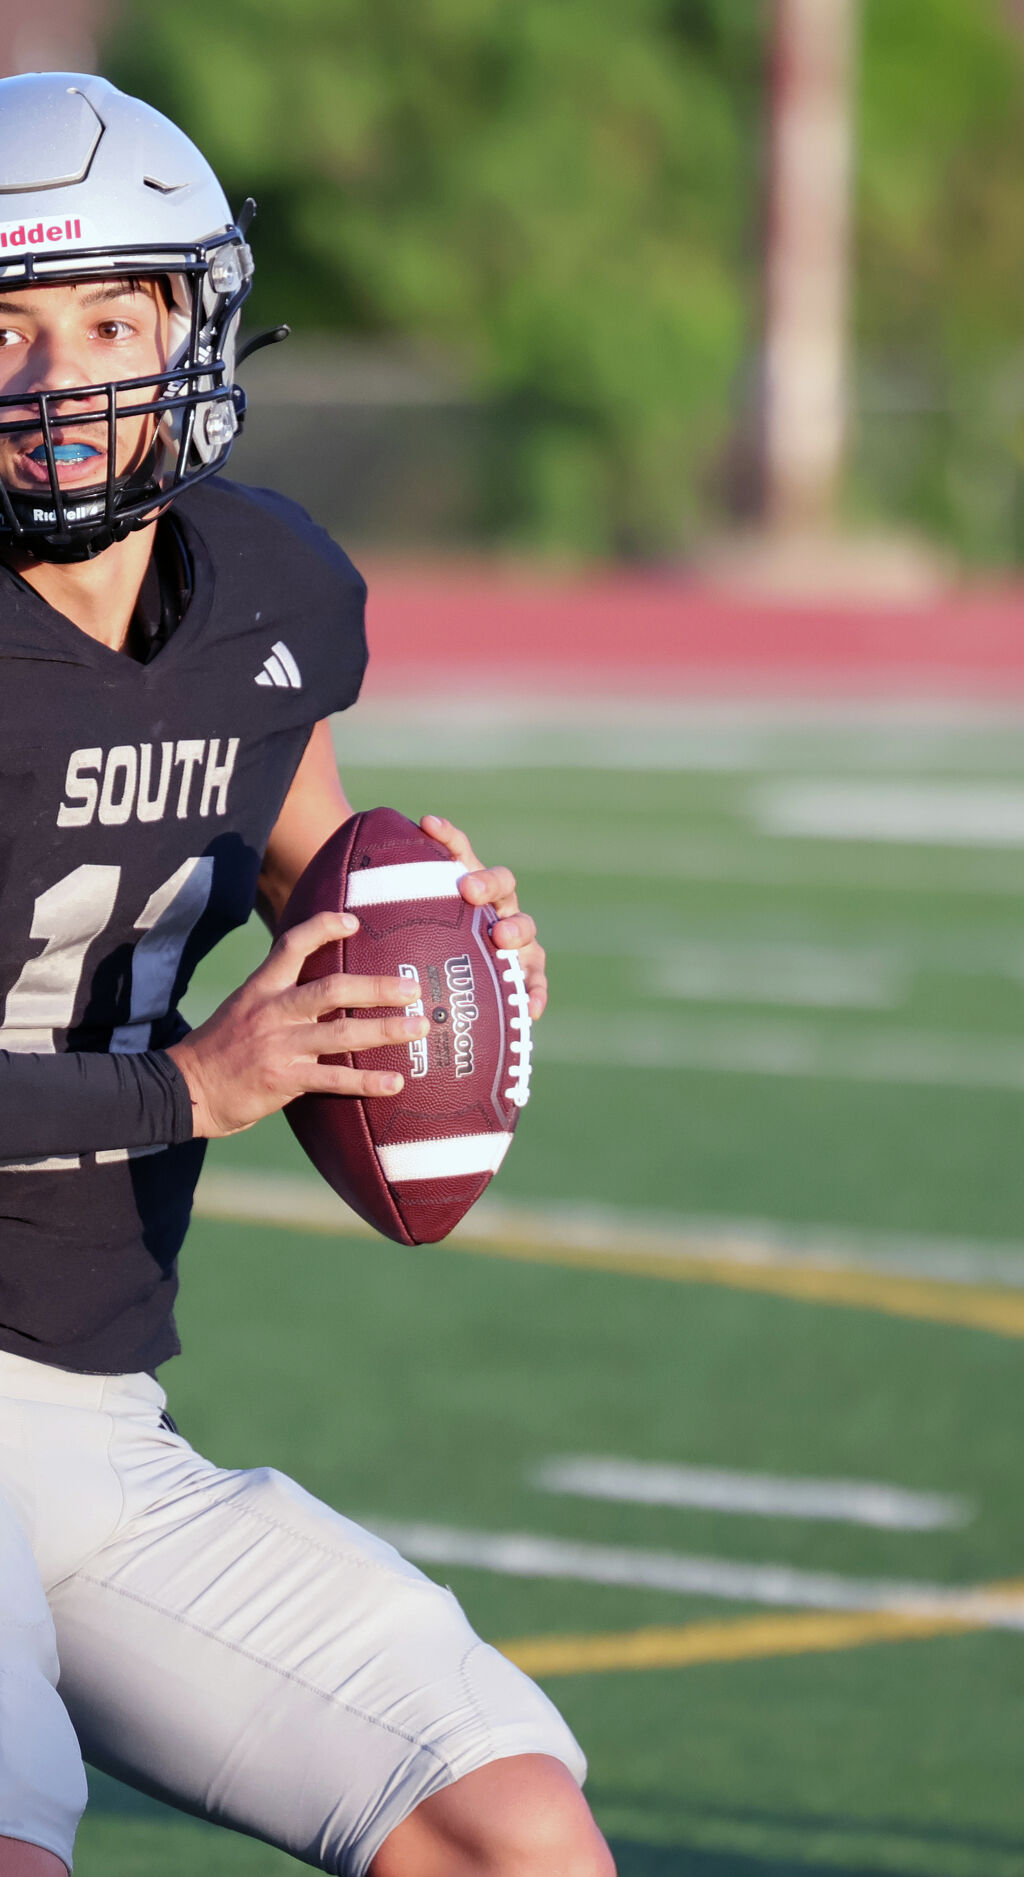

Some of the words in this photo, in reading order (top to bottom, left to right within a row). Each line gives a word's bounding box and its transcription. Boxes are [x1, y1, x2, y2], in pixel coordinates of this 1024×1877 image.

[33, 506, 86, 522] Ridell
[57, 738, 240, 828] SOUTH
[444, 954, 479, 1078] Wilson
